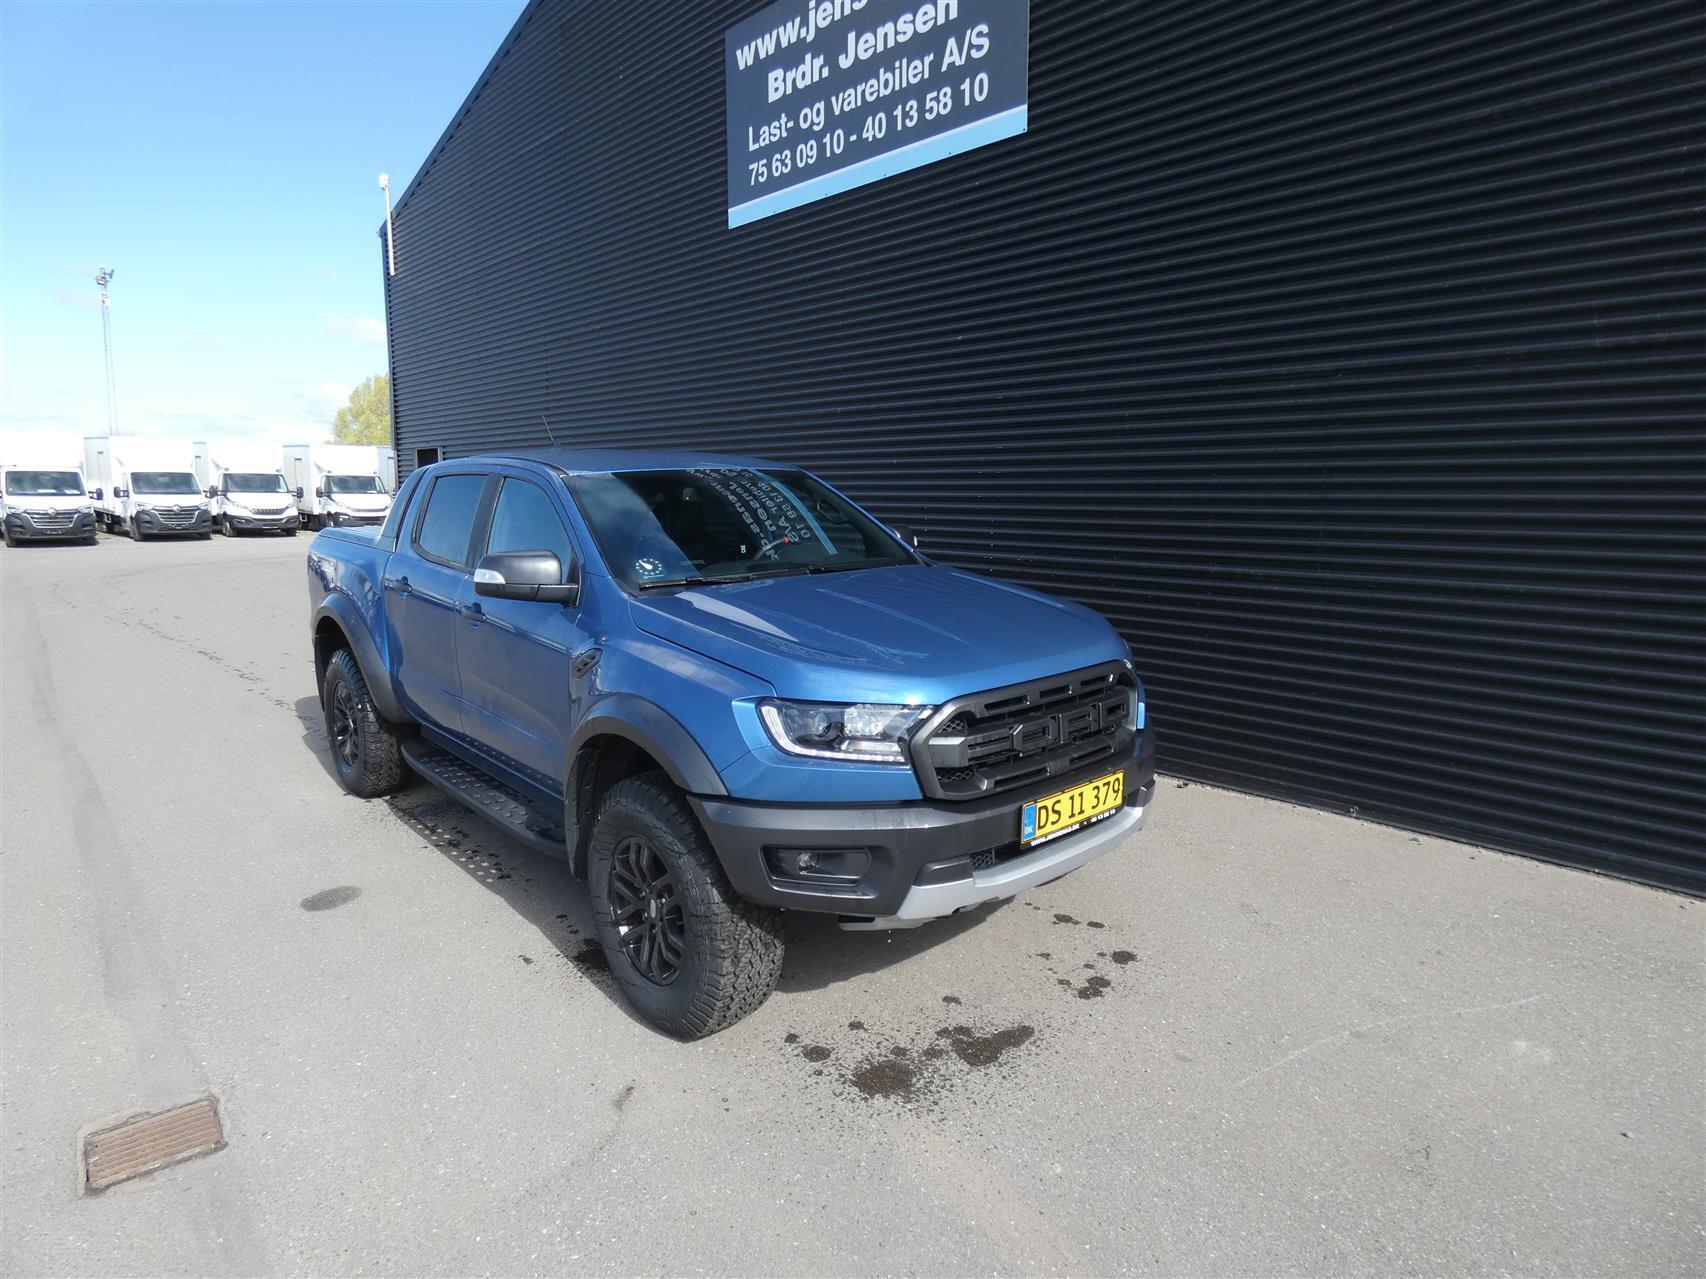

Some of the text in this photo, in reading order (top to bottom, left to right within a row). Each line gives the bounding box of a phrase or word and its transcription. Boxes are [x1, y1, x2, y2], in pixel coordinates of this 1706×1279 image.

[748, 24, 990, 152] Last- og varebiler A/S
[768, 0, 958, 104] Brdr. Jensen
[748, 159, 768, 186] 75
[771, 150, 791, 177] 63
[796, 139, 817, 168] 09
[822, 129, 845, 158] 10
[862, 112, 887, 142] 40
[893, 100, 918, 131] 13
[924, 86, 952, 121] 58
[960, 72, 989, 107] 10
[1037, 777, 1121, 831] DS 11 379
